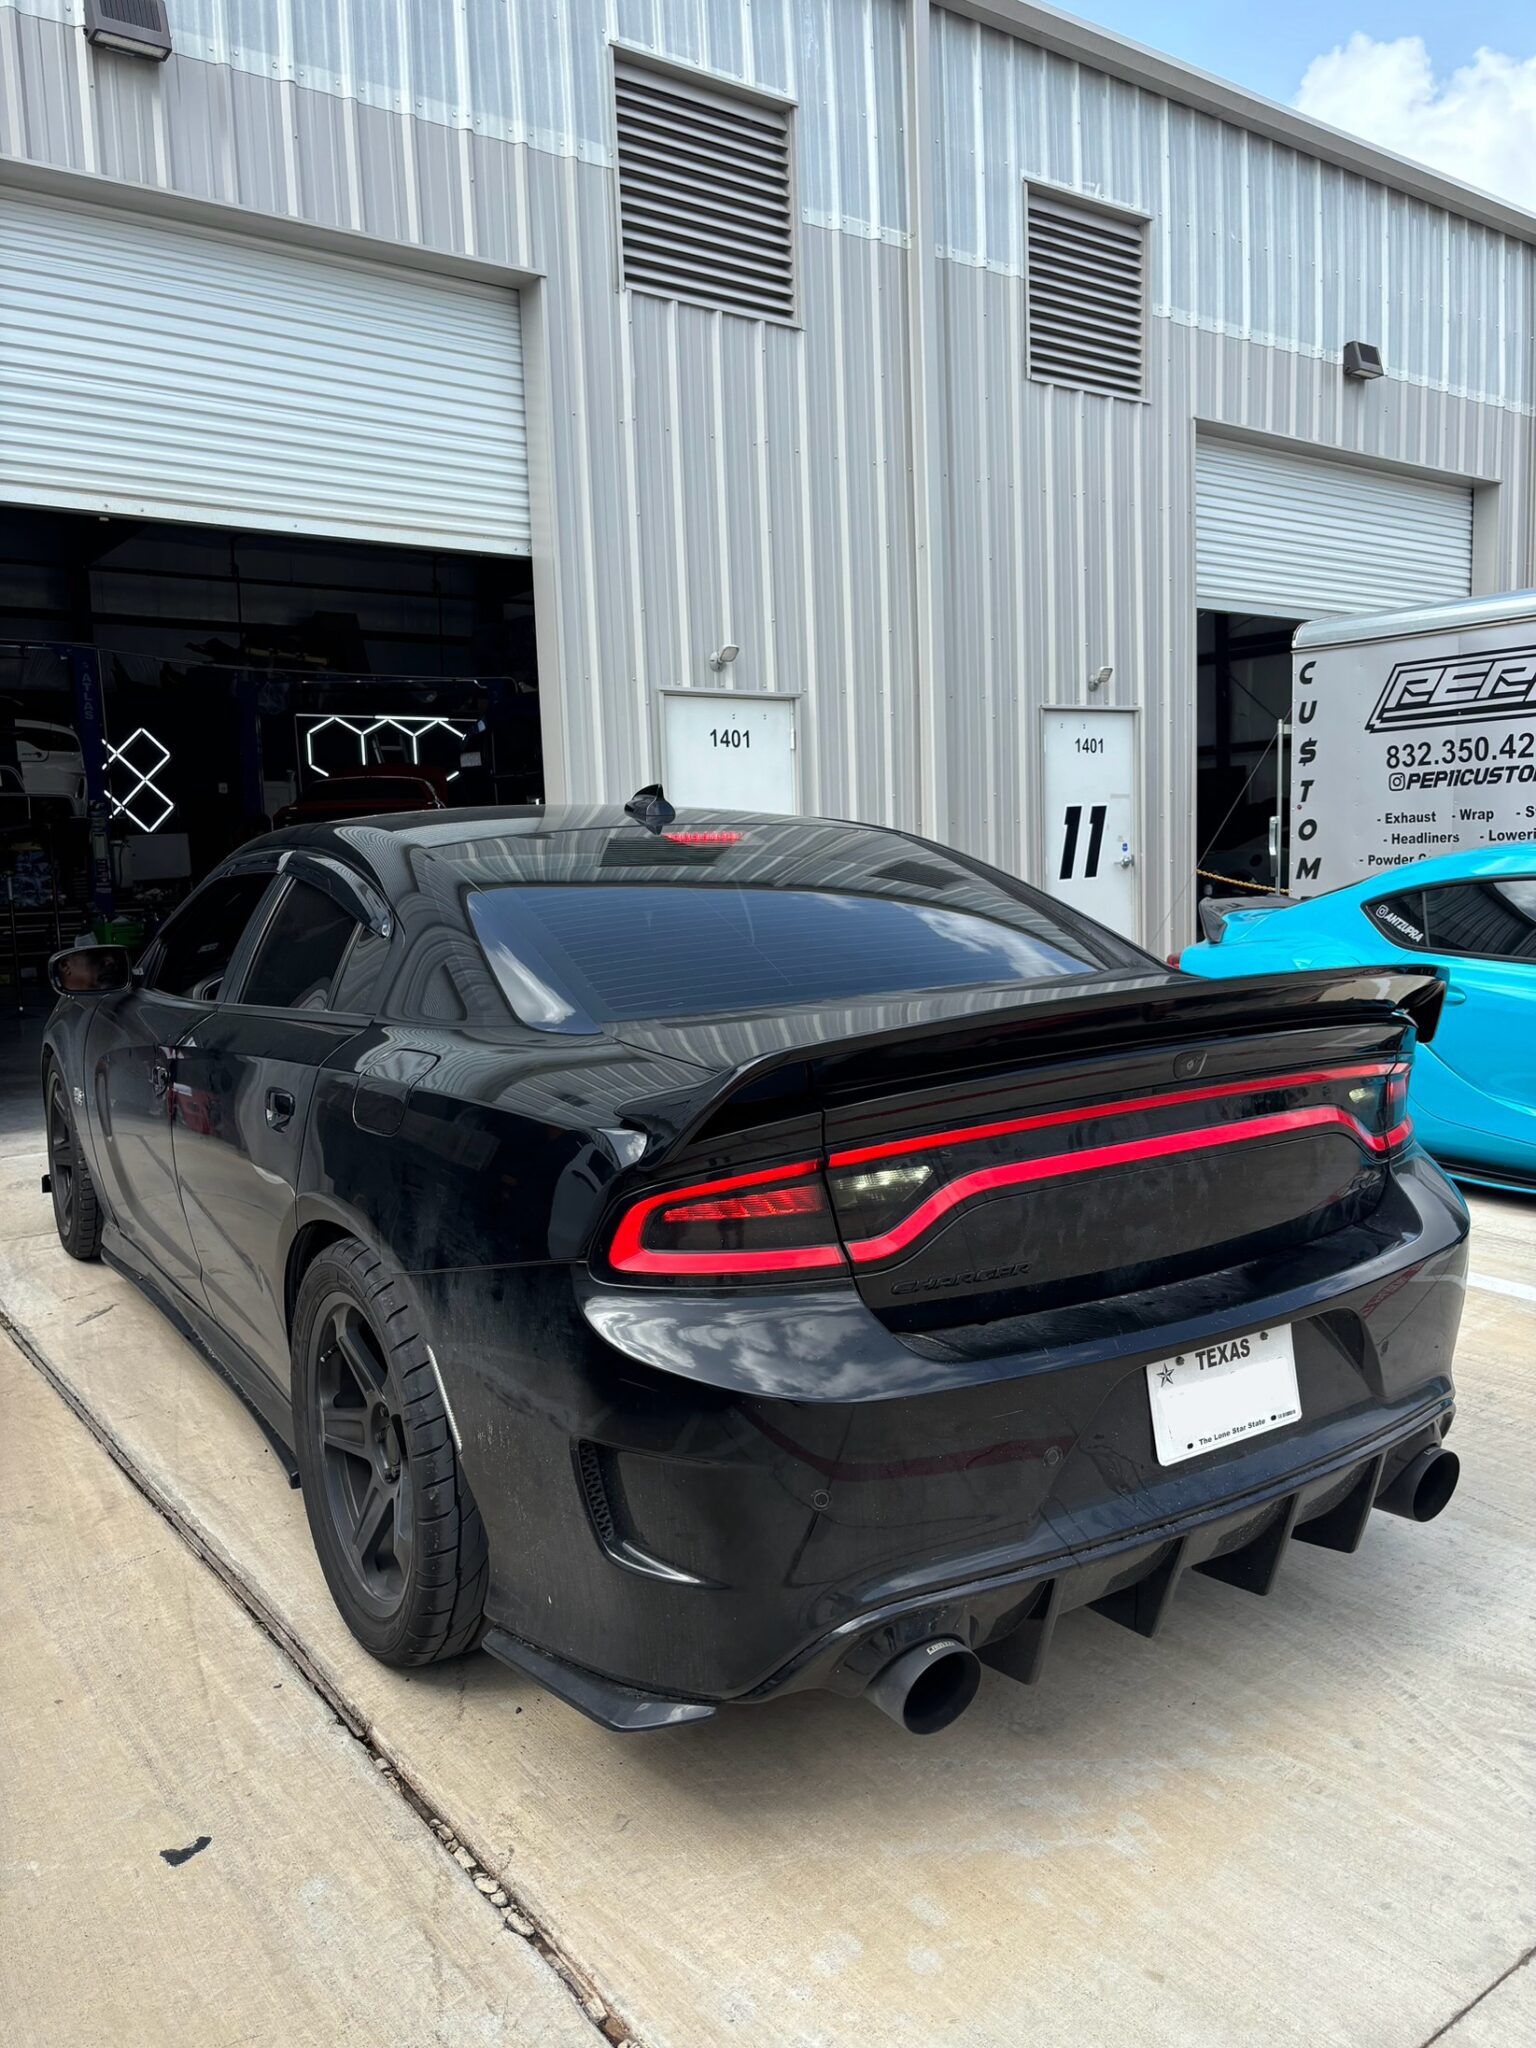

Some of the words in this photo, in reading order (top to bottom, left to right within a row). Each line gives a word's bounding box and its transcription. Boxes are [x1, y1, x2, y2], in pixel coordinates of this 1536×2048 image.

[81, 672, 94, 720] ATLAS
[710, 729, 750, 748] 1401
[1075, 738, 1104, 753] 1401
[1386, 732, 1535, 769] 832.350.42
[1296, 660, 1321, 899] CU$TOM
[1406, 765, 1536, 790] PEP11CUSTO
[1385, 811, 1436, 824] Exhaust
[1460, 809, 1494, 822] Wrap
[1059, 806, 1107, 880] 11
[1391, 832, 1460, 845] Headliners
[1368, 854, 1415, 866] Powder
[1384, 912, 1424, 942] ANTZUPRA
[891, 1262, 1031, 1295] CHARGER
[1195, 1339, 1251, 1370] TEXAS
[1199, 1437, 1212, 1445] The
[1214, 1431, 1230, 1441] Lone
[1232, 1426, 1246, 1434] Star
[1248, 1419, 1266, 1429] State
